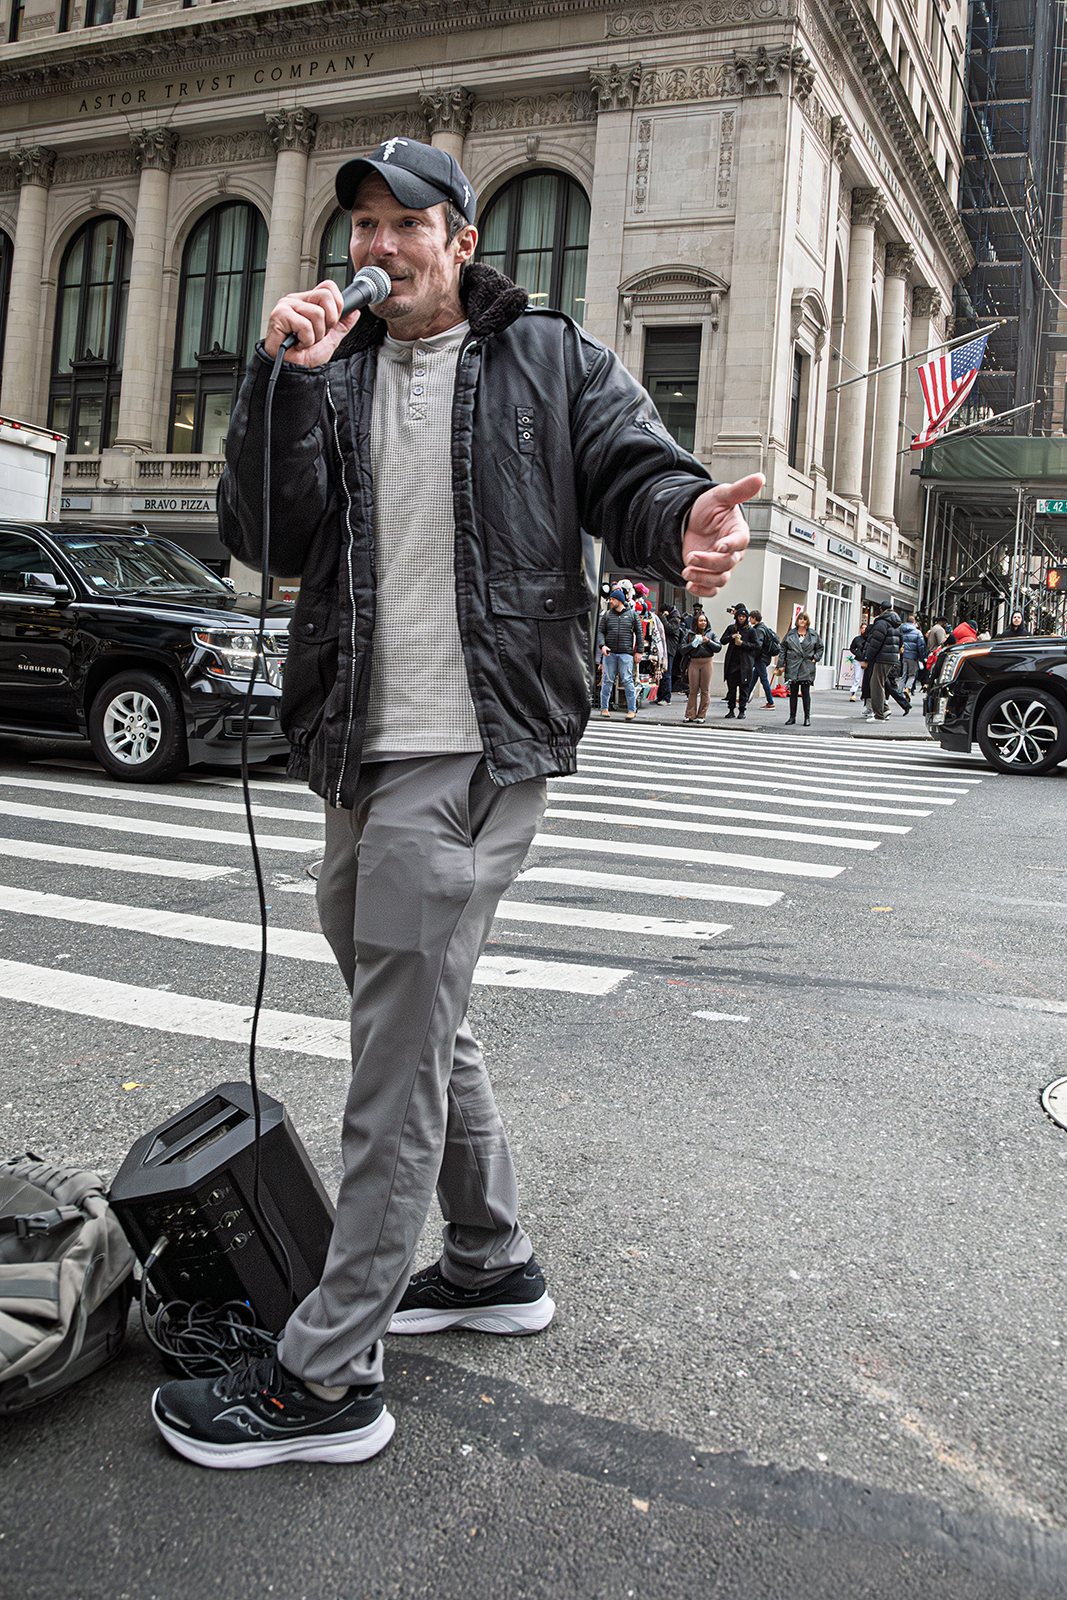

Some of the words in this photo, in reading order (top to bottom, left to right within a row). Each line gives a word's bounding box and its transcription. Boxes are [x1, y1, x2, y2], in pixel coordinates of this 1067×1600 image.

[78, 89, 147, 112] ASTOR
[164, 74, 236, 98] TRVST
[253, 52, 375, 84] COMPANY
[861, 122, 881, 166] ASTOR
[144, 499, 177, 510] BRAVO
[180, 499, 210, 510] PIZZA
[1052, 501, 1064, 512] 42
[17, 664, 64, 674] SUBURBAN
